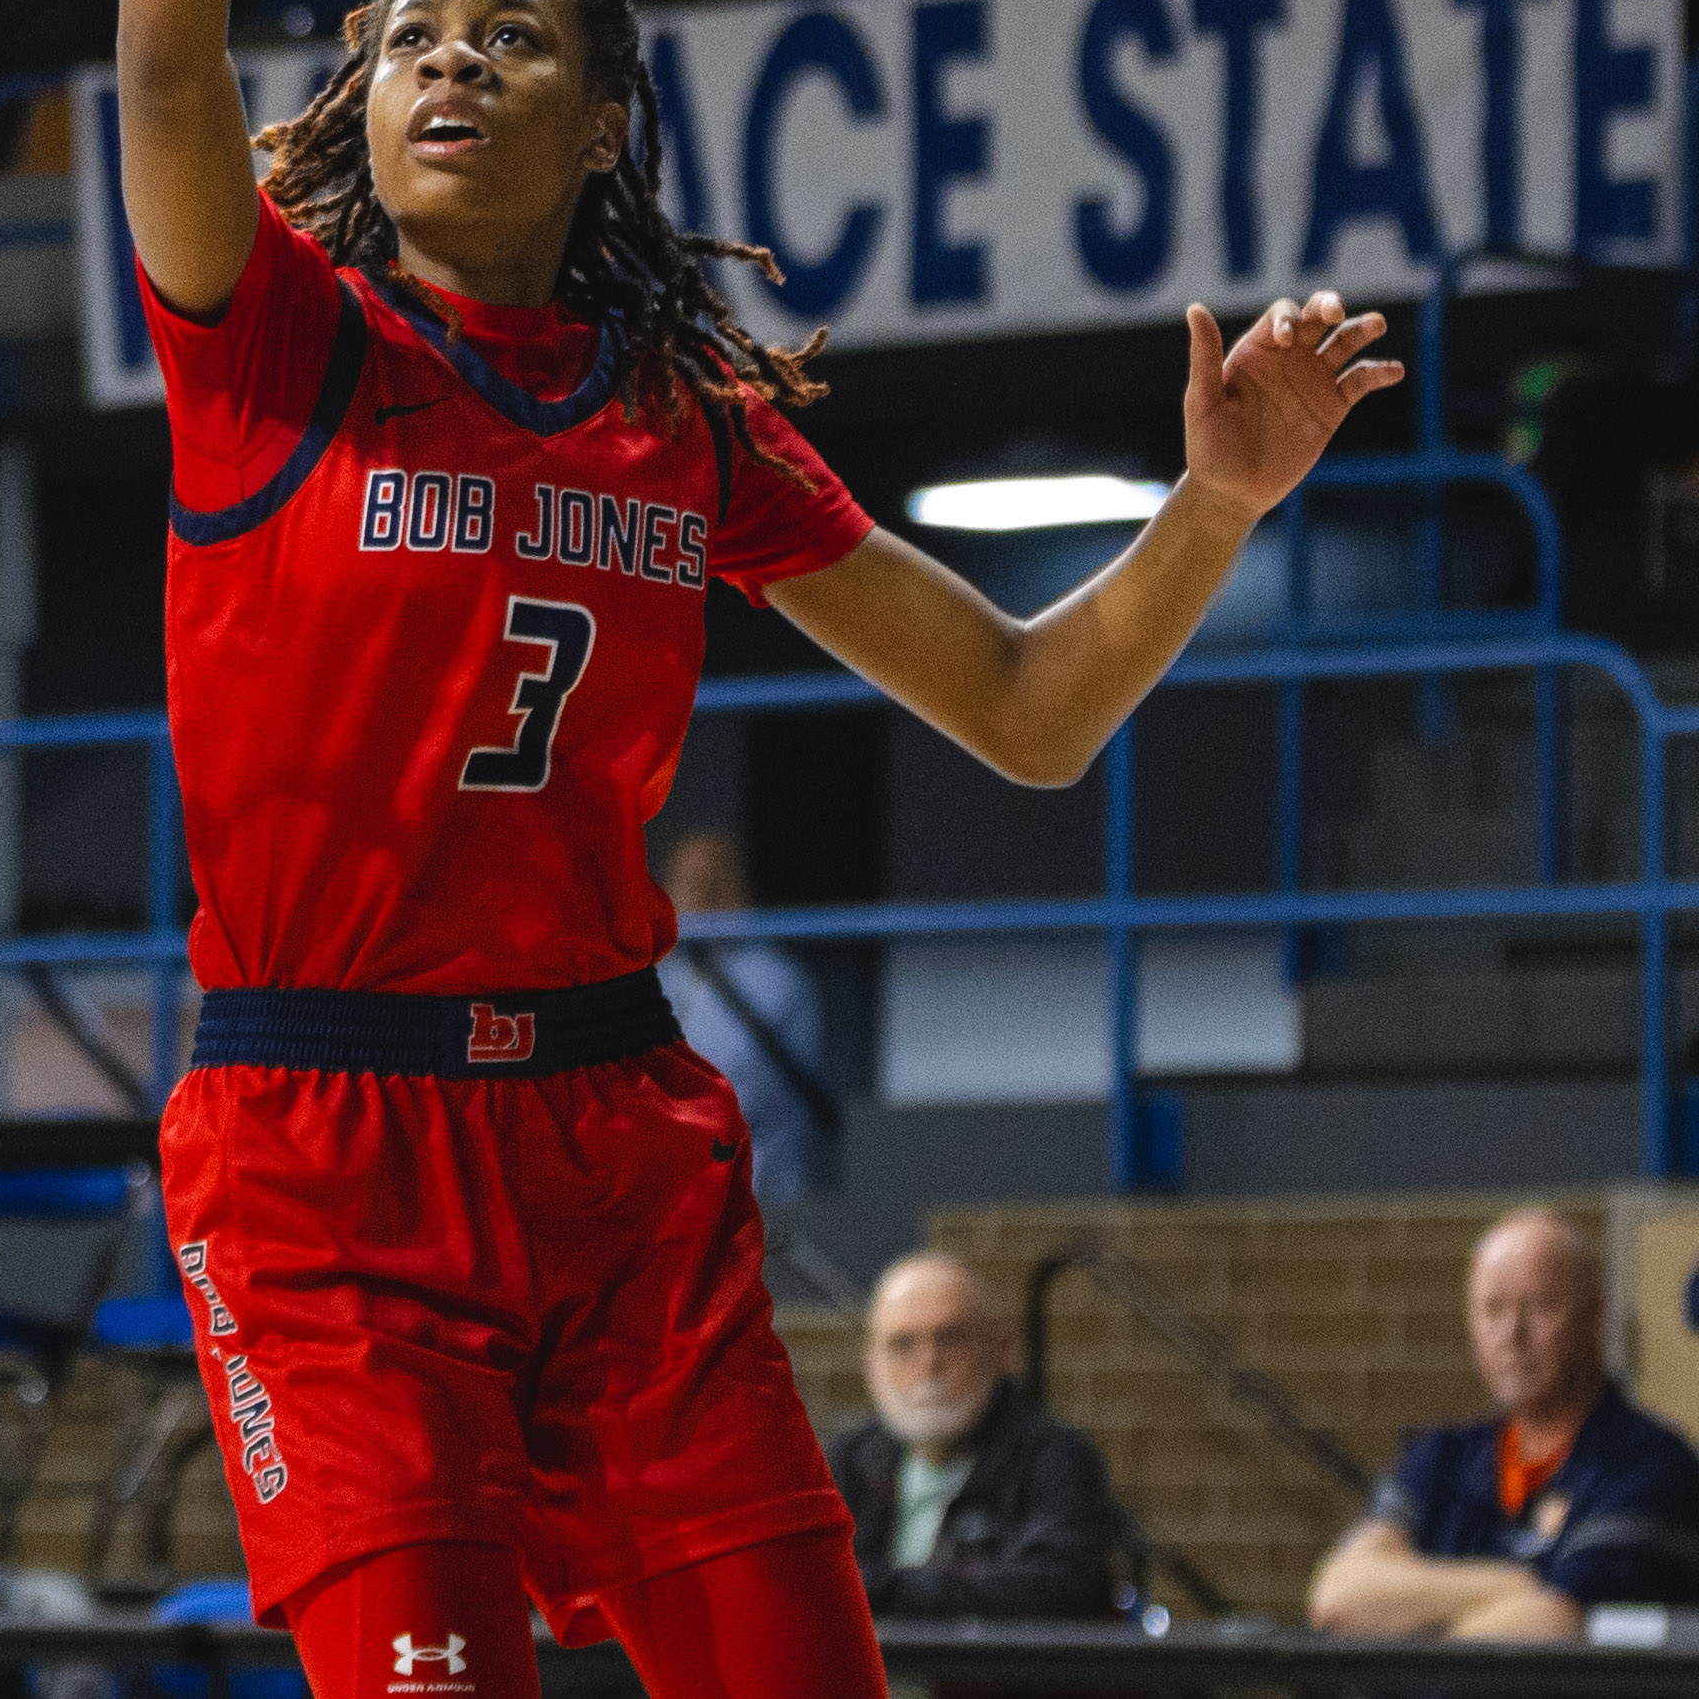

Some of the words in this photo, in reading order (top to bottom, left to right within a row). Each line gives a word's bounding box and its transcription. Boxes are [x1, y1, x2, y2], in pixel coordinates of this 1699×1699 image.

[359, 468, 495, 554] BOB
[516, 483, 707, 590] JONES
[458, 595, 596, 793] 3
